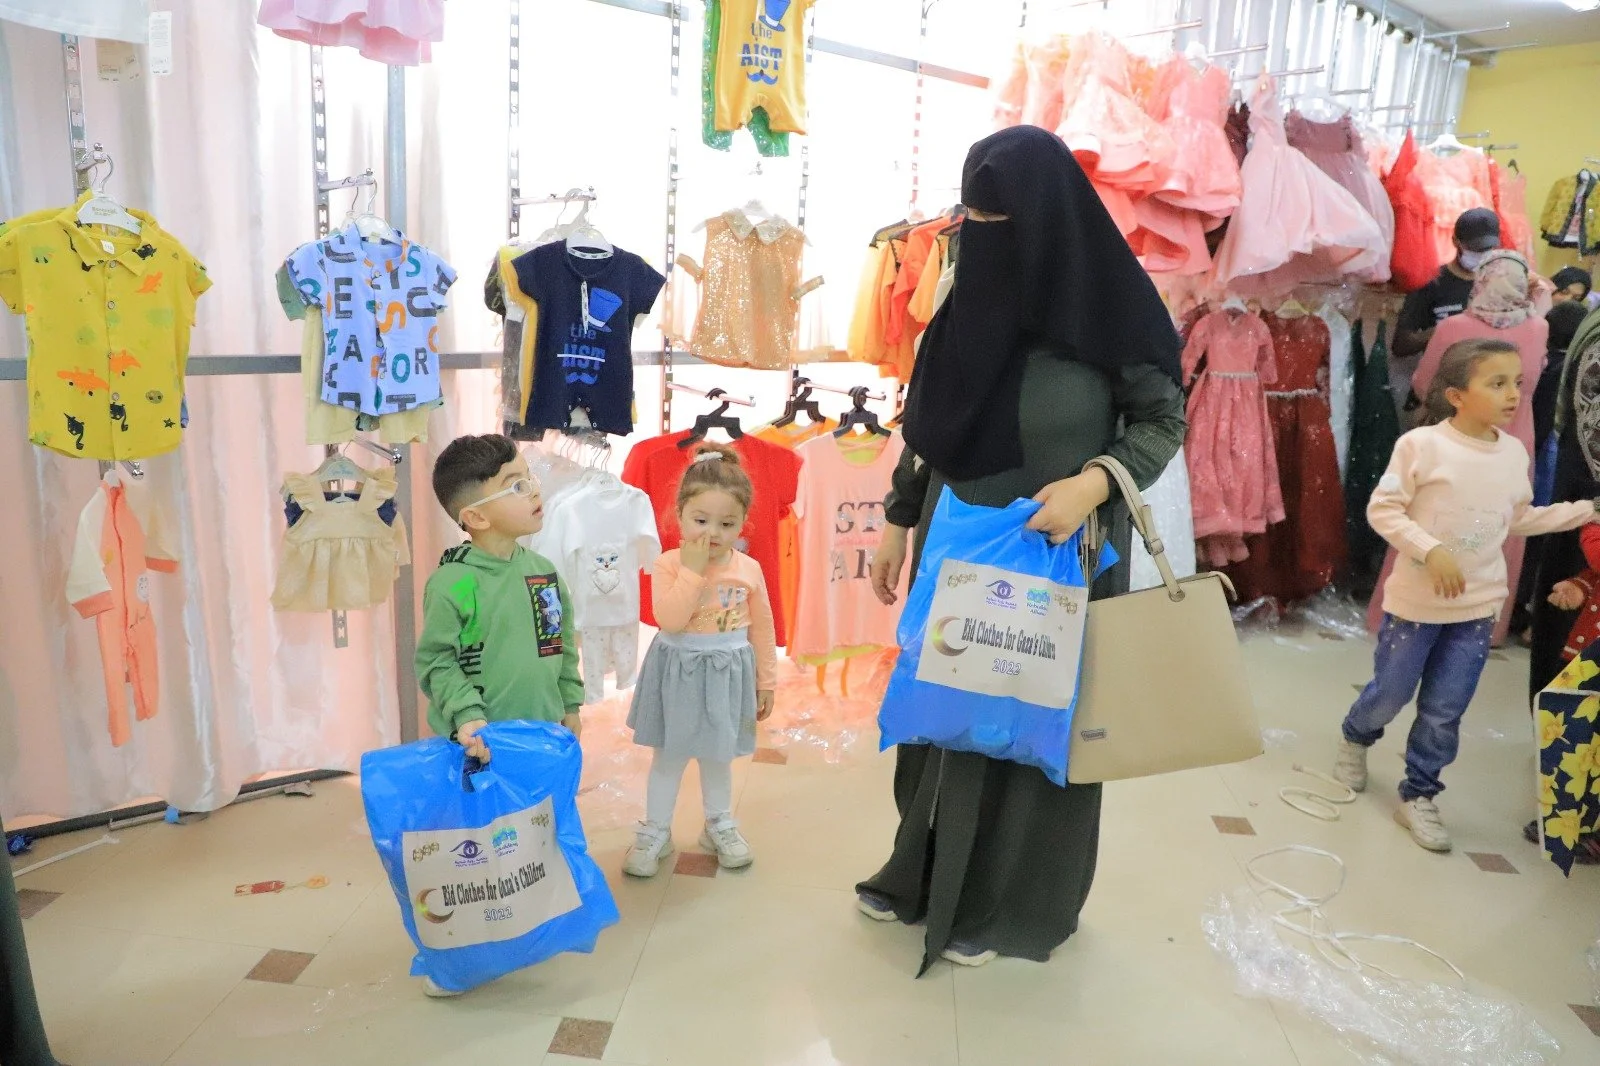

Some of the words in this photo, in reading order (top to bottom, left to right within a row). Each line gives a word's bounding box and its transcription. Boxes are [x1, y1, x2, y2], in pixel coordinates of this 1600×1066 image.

[741, 43, 782, 70] AIST
[334, 277, 353, 319] E
[343, 334, 364, 362] A
[976, 619, 1003, 649] Clothes
[1003, 625, 1017, 651] for
[992, 658, 1021, 675] 2022
[456, 878, 486, 906] Clothes
[486, 878, 497, 901] for
[518, 862, 546, 891] Children
[484, 906, 514, 922] 2022
